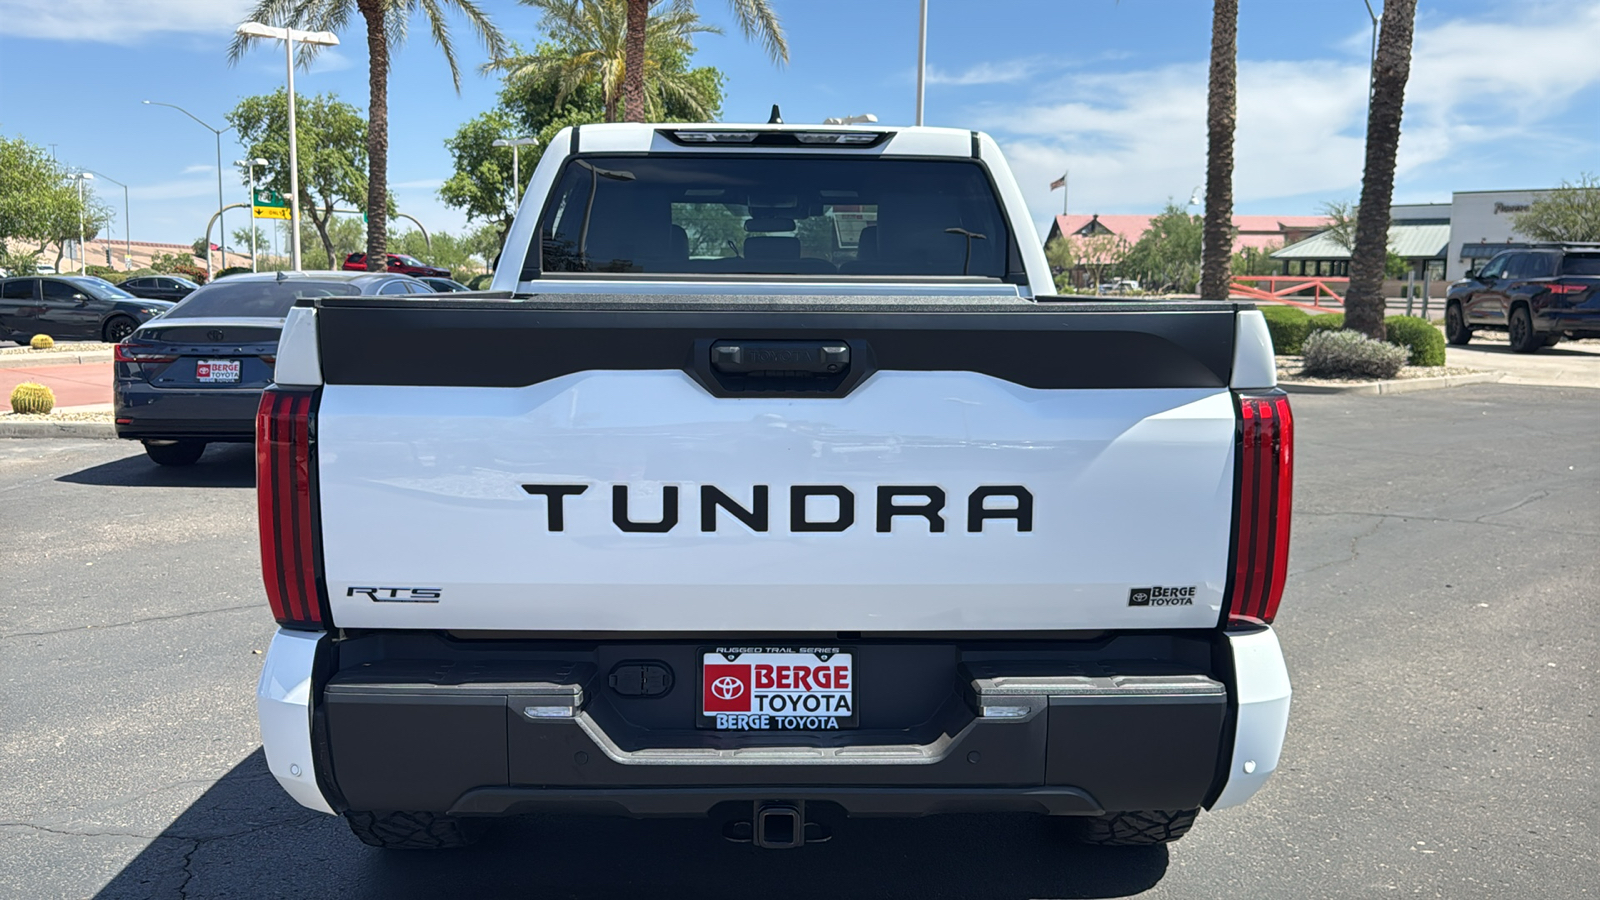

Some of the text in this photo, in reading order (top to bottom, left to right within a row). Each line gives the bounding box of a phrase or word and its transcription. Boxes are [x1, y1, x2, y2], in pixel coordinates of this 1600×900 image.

[750, 350, 812, 361] TOYOTA
[211, 364, 240, 372] BERGE
[521, 485, 1034, 533] TUNDRA
[346, 587, 443, 603] RTS
[1152, 586, 1196, 597] BERGE
[1150, 597, 1193, 606] TOYOTA
[754, 664, 850, 692] BERGE
[754, 694, 851, 712] TOYOTA
[716, 714, 839, 731] BERGE TOYOTA
